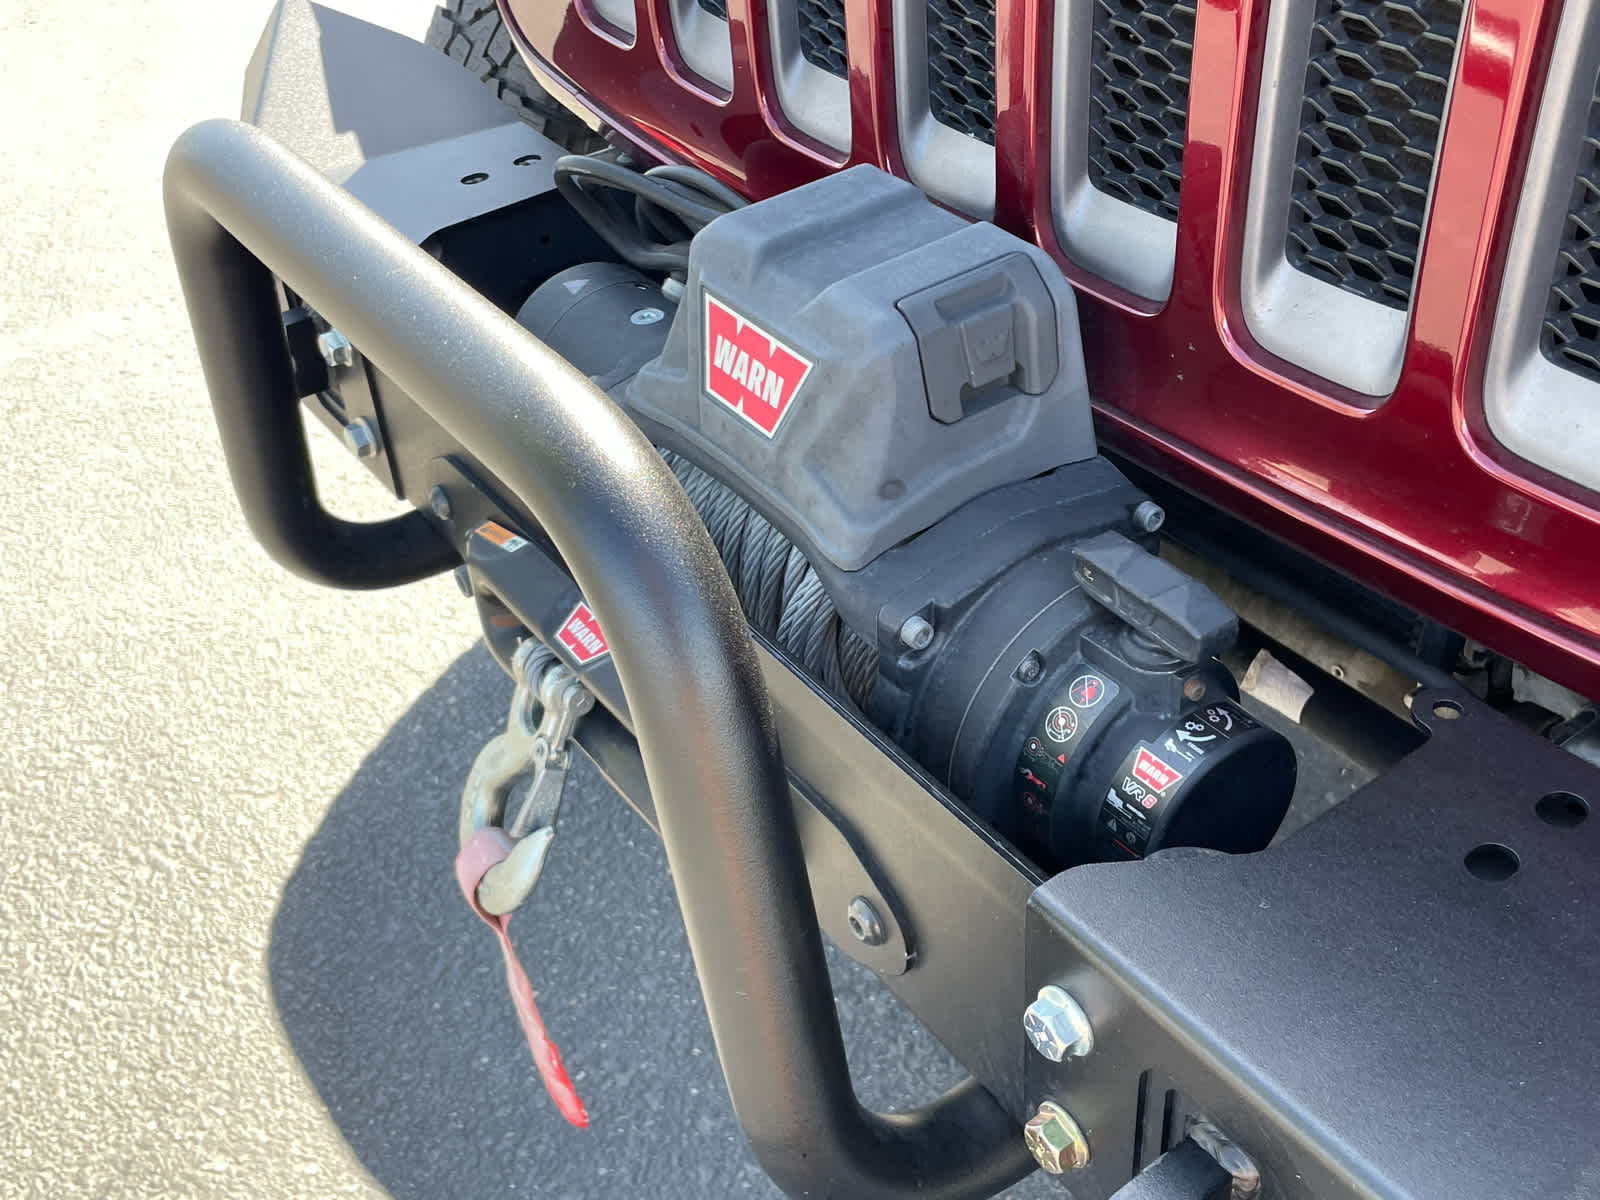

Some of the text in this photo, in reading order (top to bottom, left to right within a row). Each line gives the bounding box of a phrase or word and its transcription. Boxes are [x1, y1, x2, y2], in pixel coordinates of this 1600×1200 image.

[713, 333, 785, 410] WARN
[567, 618, 604, 654] WARN
[1138, 759, 1170, 786] WARN
